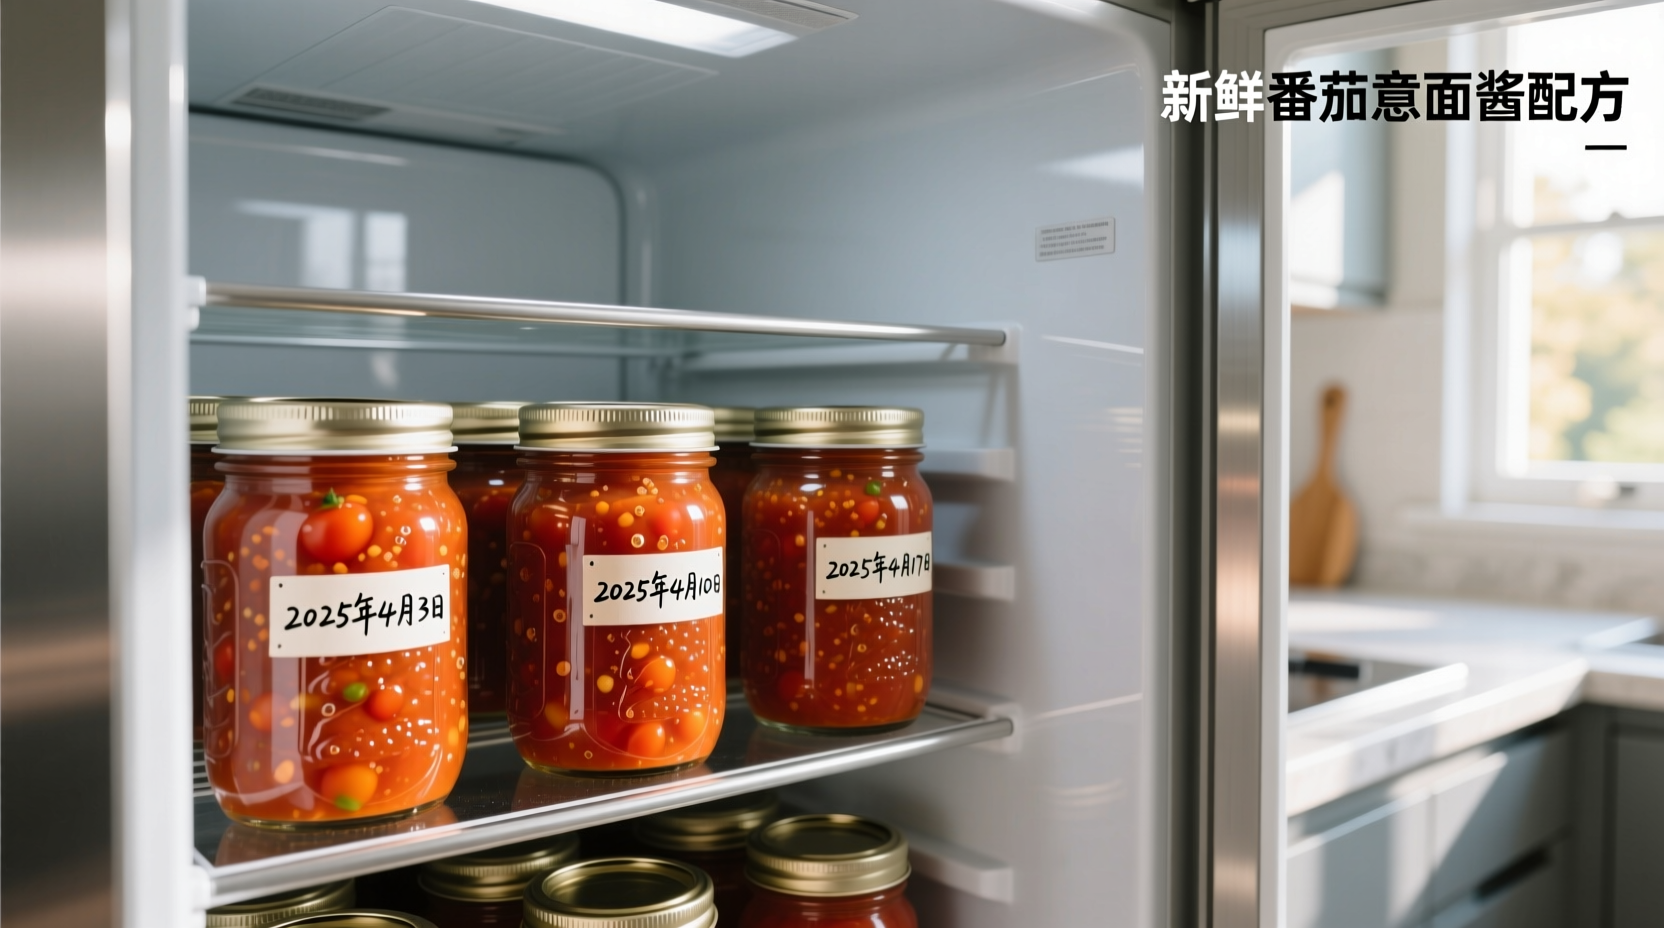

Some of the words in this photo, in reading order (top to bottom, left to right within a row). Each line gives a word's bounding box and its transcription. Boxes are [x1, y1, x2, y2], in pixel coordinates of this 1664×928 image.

[825, 551, 930, 584] 2025年4月17日
[594, 571, 720, 609] 2025年4月10日
[284, 592, 444, 636] 2025年4月3日
